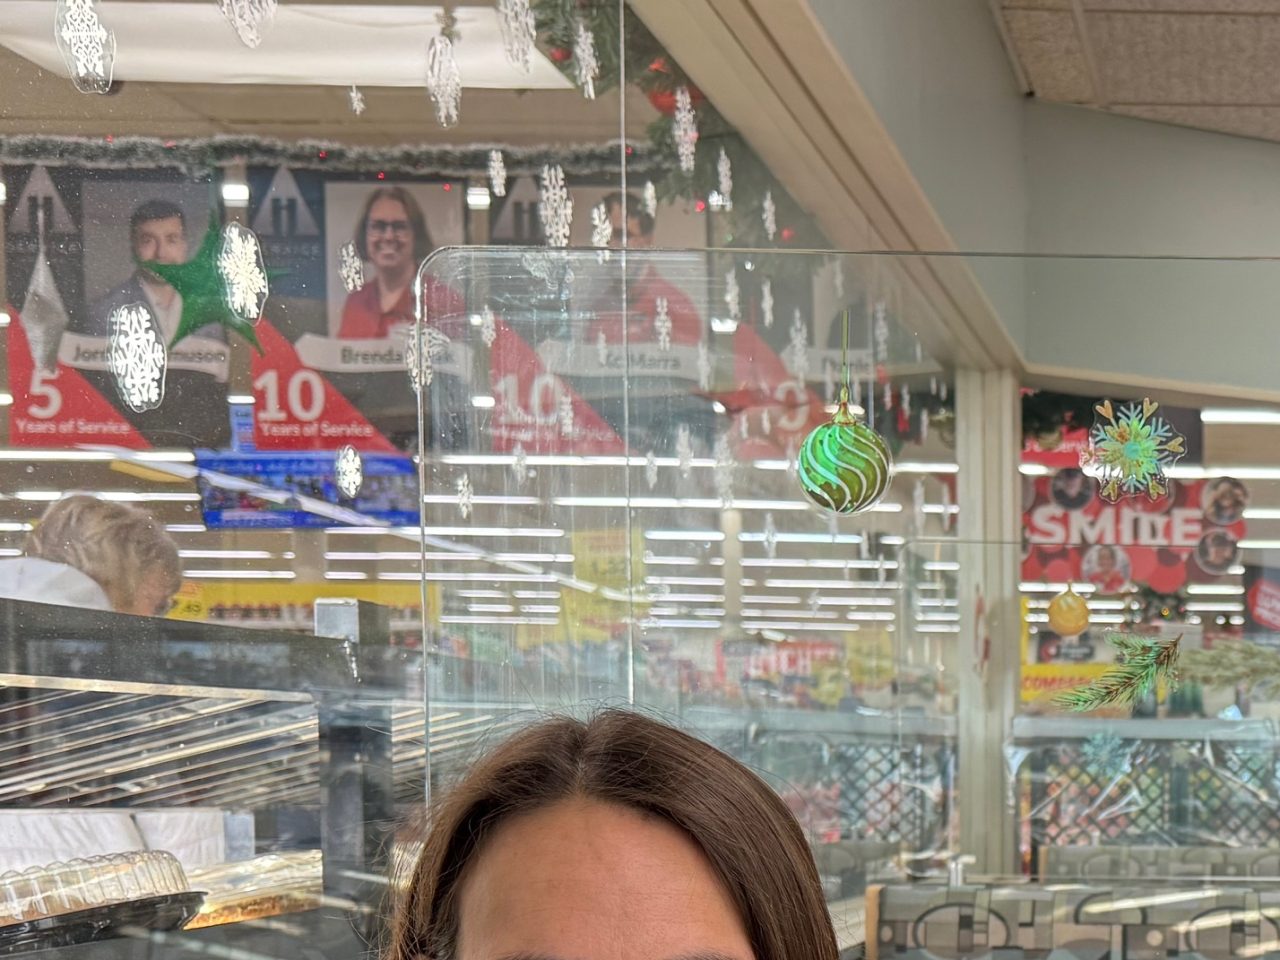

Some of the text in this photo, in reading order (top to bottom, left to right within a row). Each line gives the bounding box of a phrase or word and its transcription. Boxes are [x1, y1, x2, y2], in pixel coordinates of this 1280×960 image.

[27, 367, 62, 420] 5
[254, 369, 325, 422] 10
[16, 417, 130, 434] Years of Service
[261, 423, 300, 437] Years
[302, 421, 318, 437] of
[320, 420, 374, 438] Service
